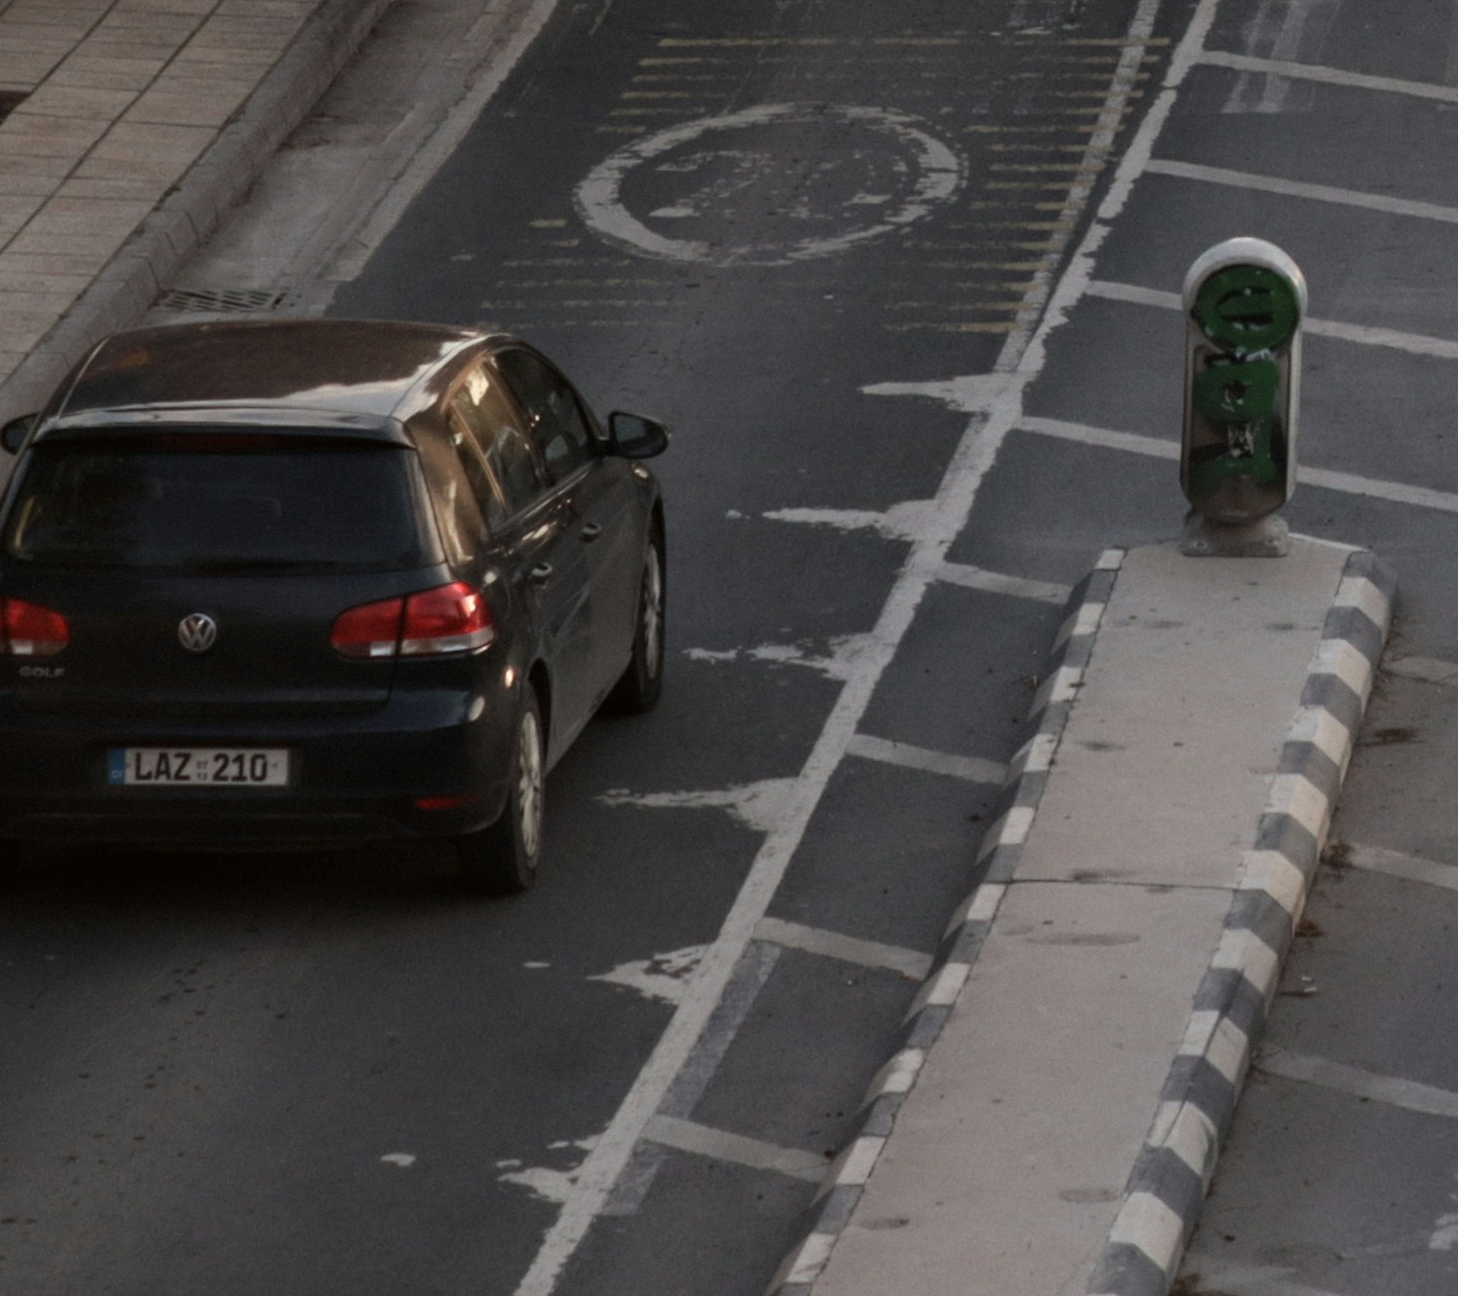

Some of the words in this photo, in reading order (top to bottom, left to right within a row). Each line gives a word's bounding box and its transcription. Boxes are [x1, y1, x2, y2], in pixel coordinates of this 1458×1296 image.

[19, 666, 66, 678] GOLF
[134, 752, 192, 781] LAZ
[211, 753, 268, 783] 210
